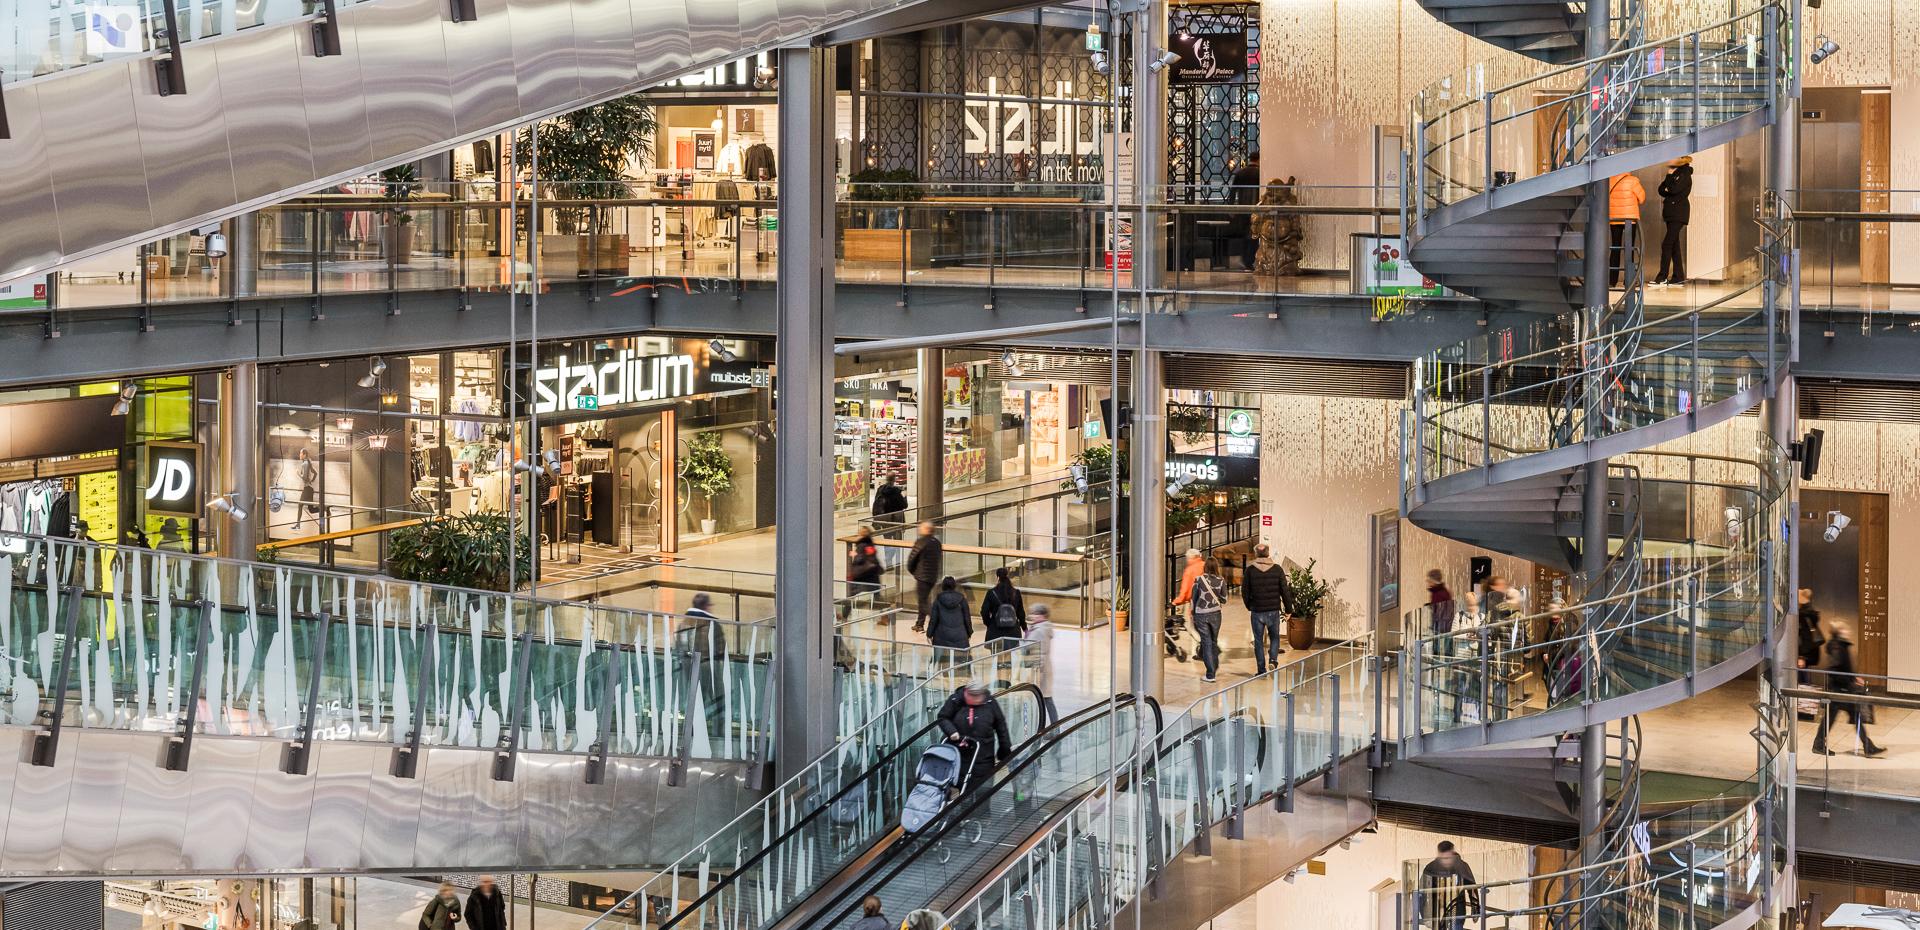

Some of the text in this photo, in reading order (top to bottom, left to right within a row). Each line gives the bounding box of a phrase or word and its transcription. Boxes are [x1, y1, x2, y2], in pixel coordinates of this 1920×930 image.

[1056, 161, 1073, 182] the
[1078, 165, 1104, 181] mov
[530, 348, 694, 413] stadium
[145, 458, 191, 501] JD
